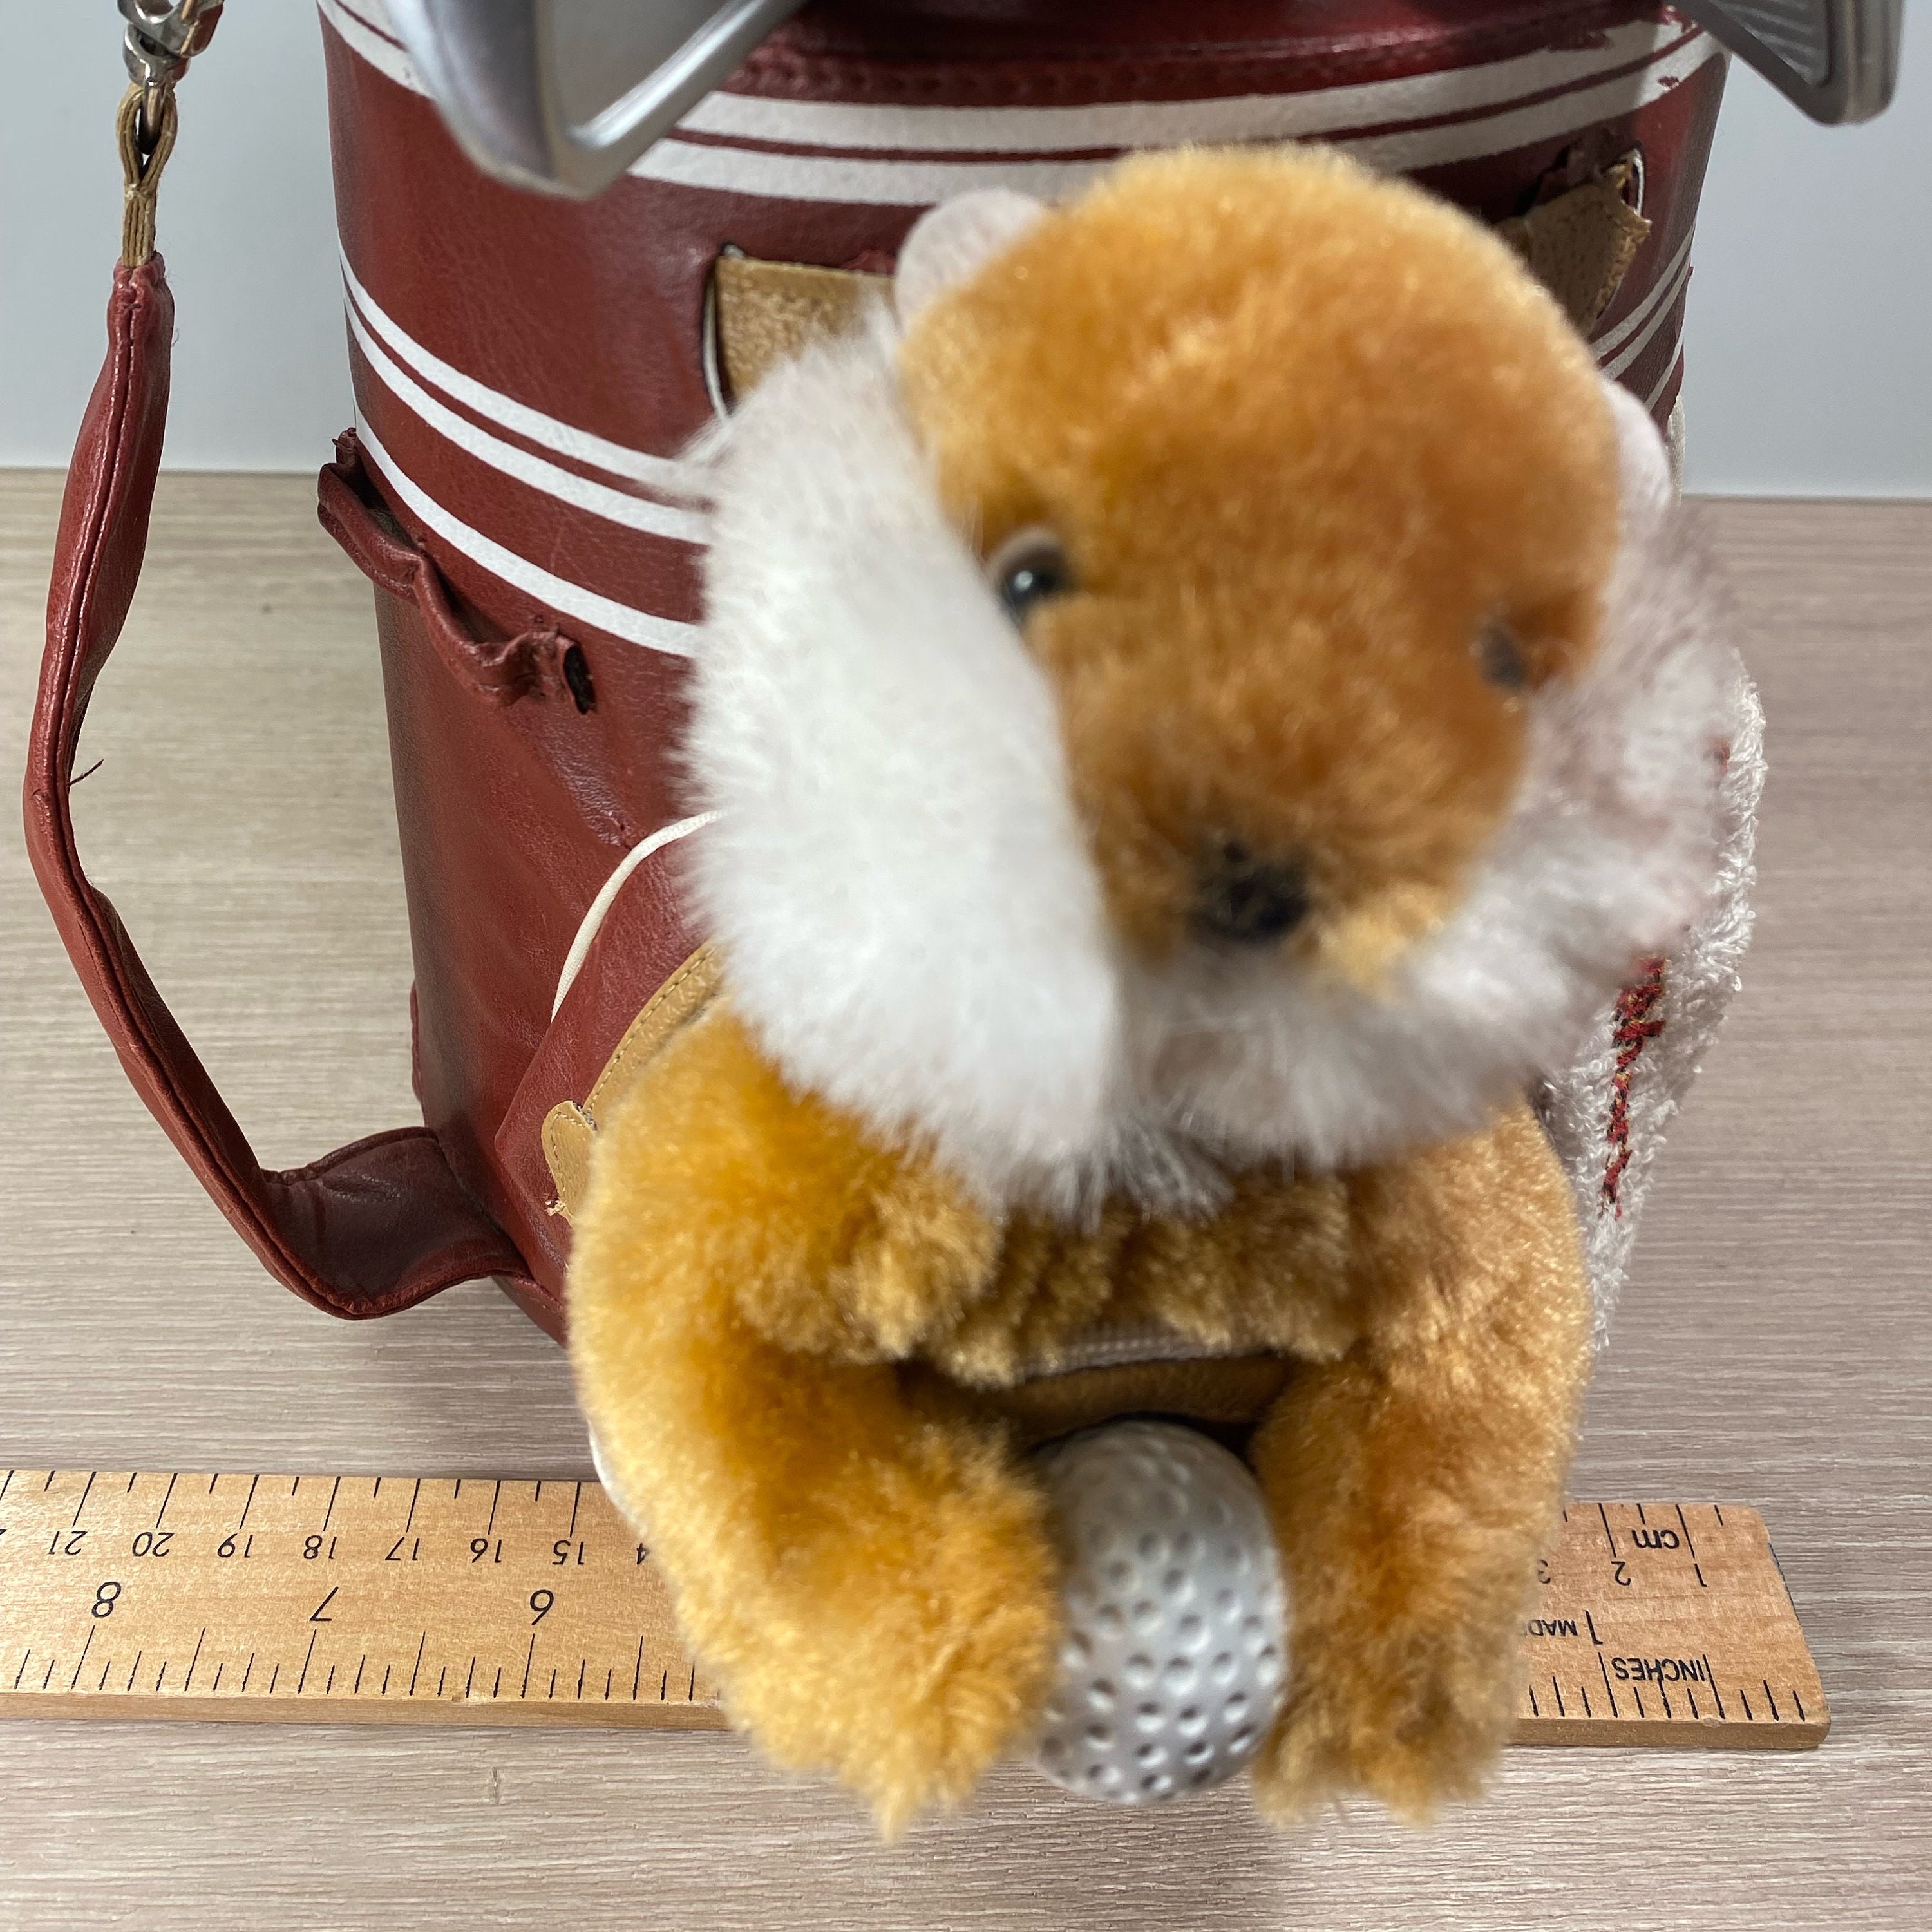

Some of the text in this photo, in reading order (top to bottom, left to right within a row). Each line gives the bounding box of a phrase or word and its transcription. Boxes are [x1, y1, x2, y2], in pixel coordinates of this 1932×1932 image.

[48, 1530, 88, 1556] 21
[131, 1531, 175, 1557] 20
[217, 1532, 254, 1558] 19
[303, 1535, 338, 1560] 18
[384, 1536, 421, 1562] 17
[470, 1538, 502, 1564] 16
[552, 1539, 585, 1566] 15
[1631, 1530, 1680, 1549] cm
[1610, 1560, 1631, 1586] 2
[1693, 1563, 1708, 1587] 1
[91, 1581, 555, 1626] 6 7 8
[1522, 1619, 1578, 1636] MAD
[1584, 1609, 1604, 1646] 1
[1611, 1657, 1705, 1682] INCHES
